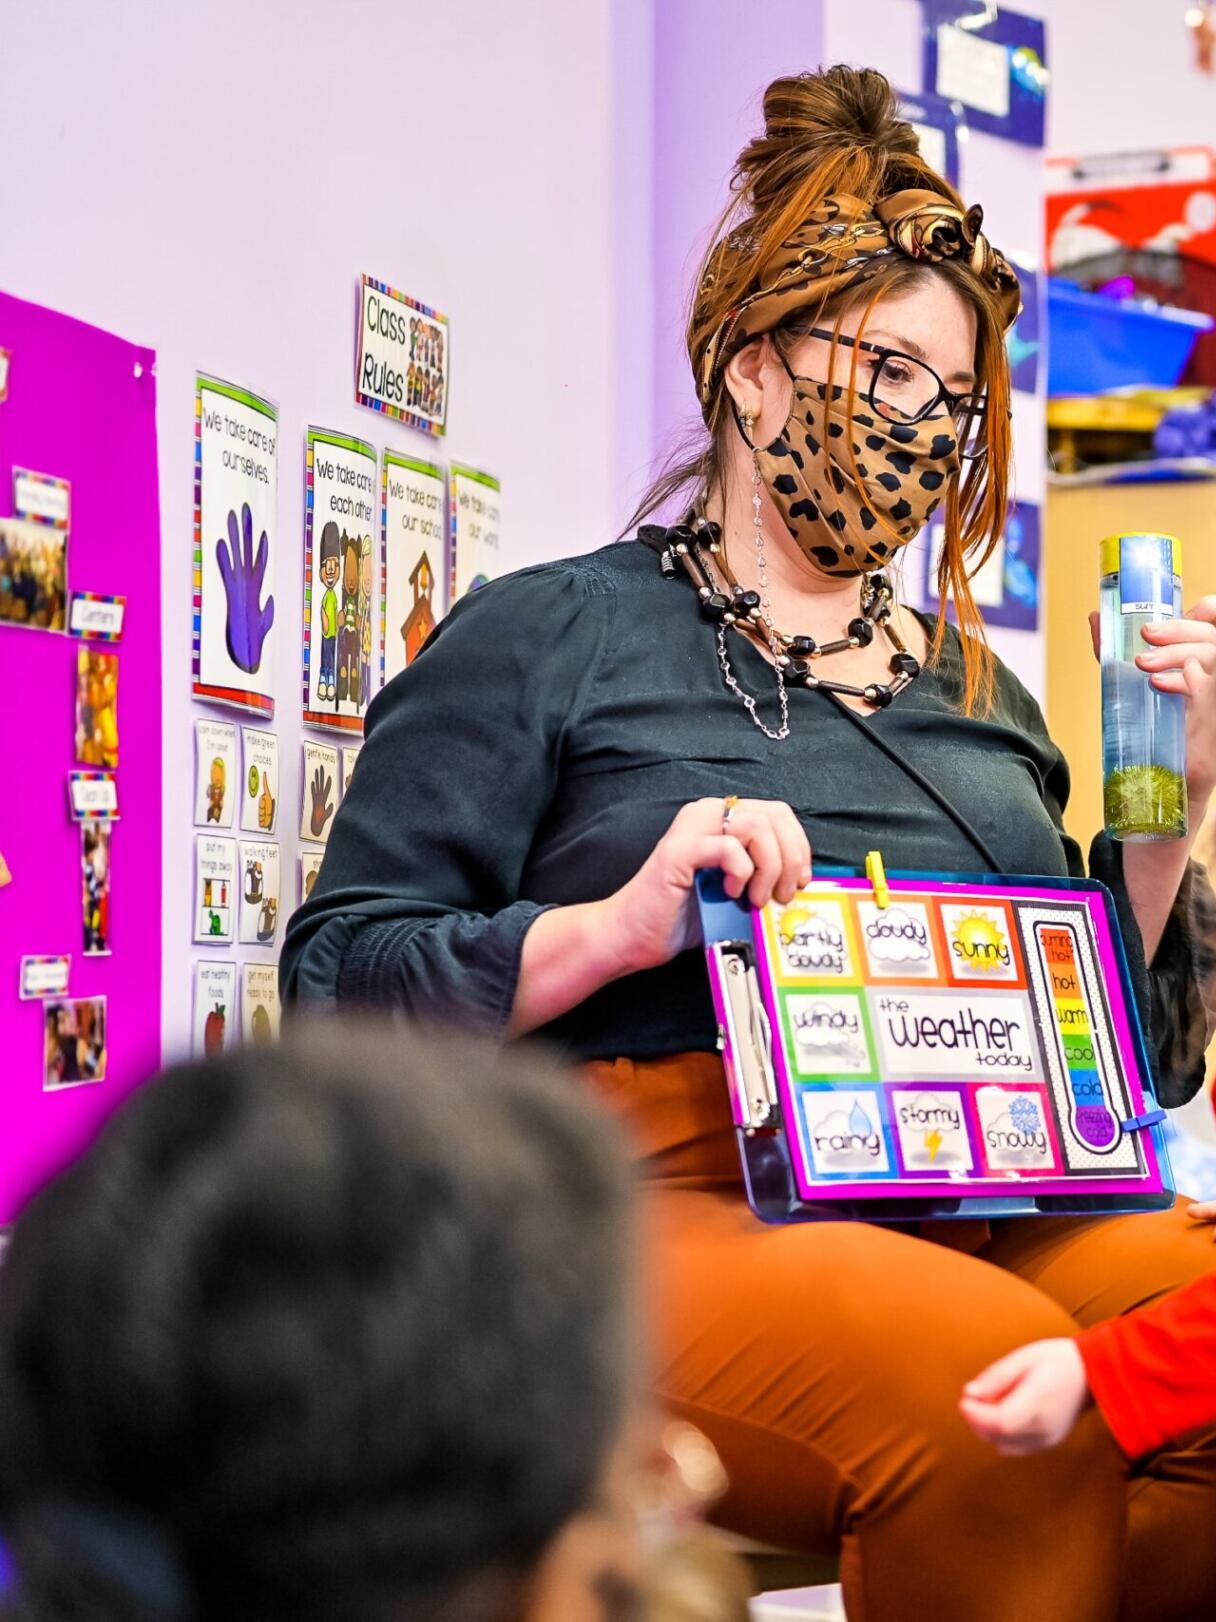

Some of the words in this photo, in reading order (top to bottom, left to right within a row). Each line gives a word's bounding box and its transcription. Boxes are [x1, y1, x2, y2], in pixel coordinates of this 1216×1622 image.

[367, 295, 406, 345] Class
[362, 352, 404, 402] Rules
[203, 407, 222, 432] We
[225, 415, 246, 441] take
[247, 428, 267, 452] care
[316, 458, 334, 480] We
[336, 463, 356, 486] take
[389, 479, 404, 500] We
[406, 485, 425, 506] take
[330, 495, 355, 516] each
[402, 514, 419, 531] our
[779, 930, 843, 952] partly
[866, 920, 927, 945] cloudy
[788, 953, 843, 973] cloudy
[952, 940, 1011, 966] sunny
[1051, 947, 1071, 962] hot
[1052, 972, 1076, 989] hot
[880, 998, 909, 1013] the
[1056, 1007, 1088, 1024] warm
[794, 1012, 858, 1033] windy
[888, 1008, 1020, 1051] weather
[976, 1052, 1032, 1071] today
[1064, 1043, 1096, 1061] cool
[1072, 1080, 1104, 1097] cold
[900, 1105, 960, 1130] stormy
[815, 1131, 881, 1156] rainy
[986, 1130, 1047, 1154] snowy
